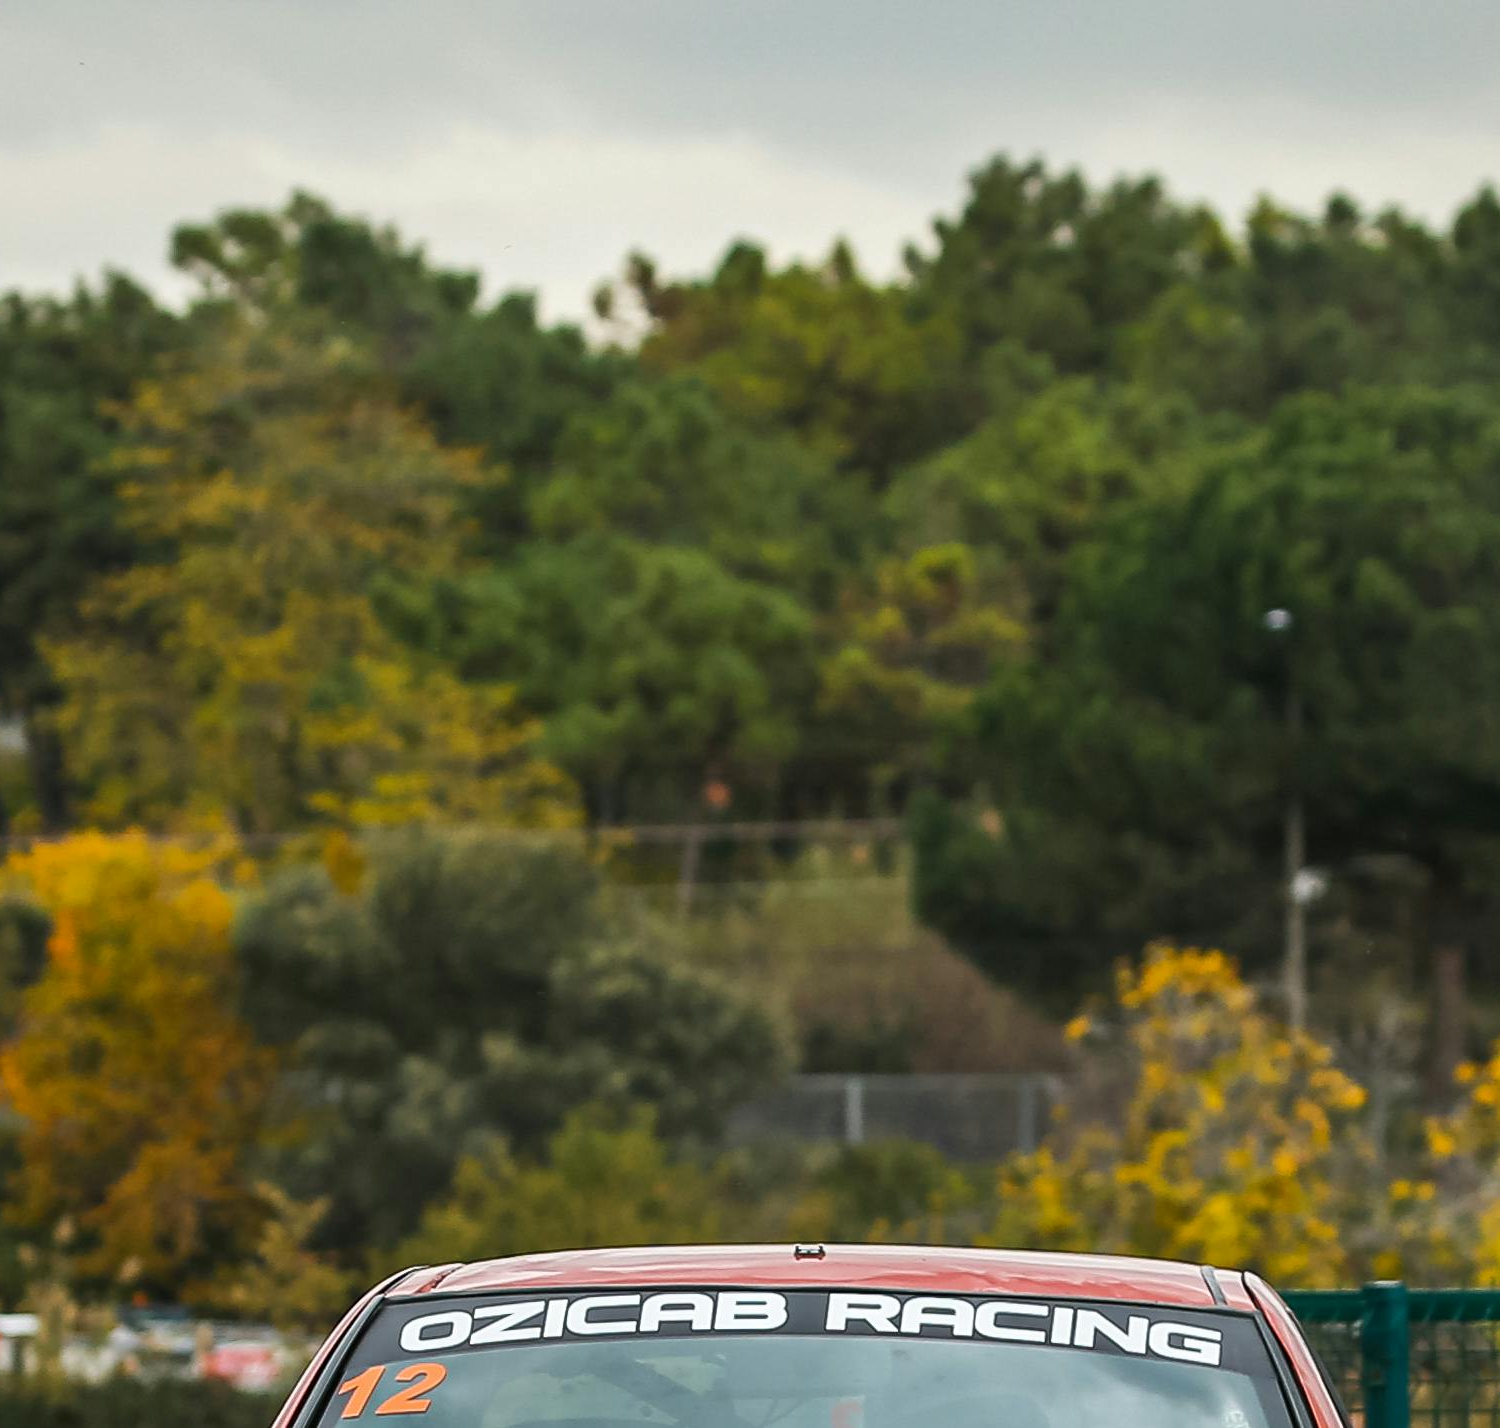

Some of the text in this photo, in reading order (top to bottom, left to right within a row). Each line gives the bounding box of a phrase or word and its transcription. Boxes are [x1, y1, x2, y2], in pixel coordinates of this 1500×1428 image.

[398, 1291, 1223, 1367] OZICAB RACING
[338, 1362, 448, 1418] 12
